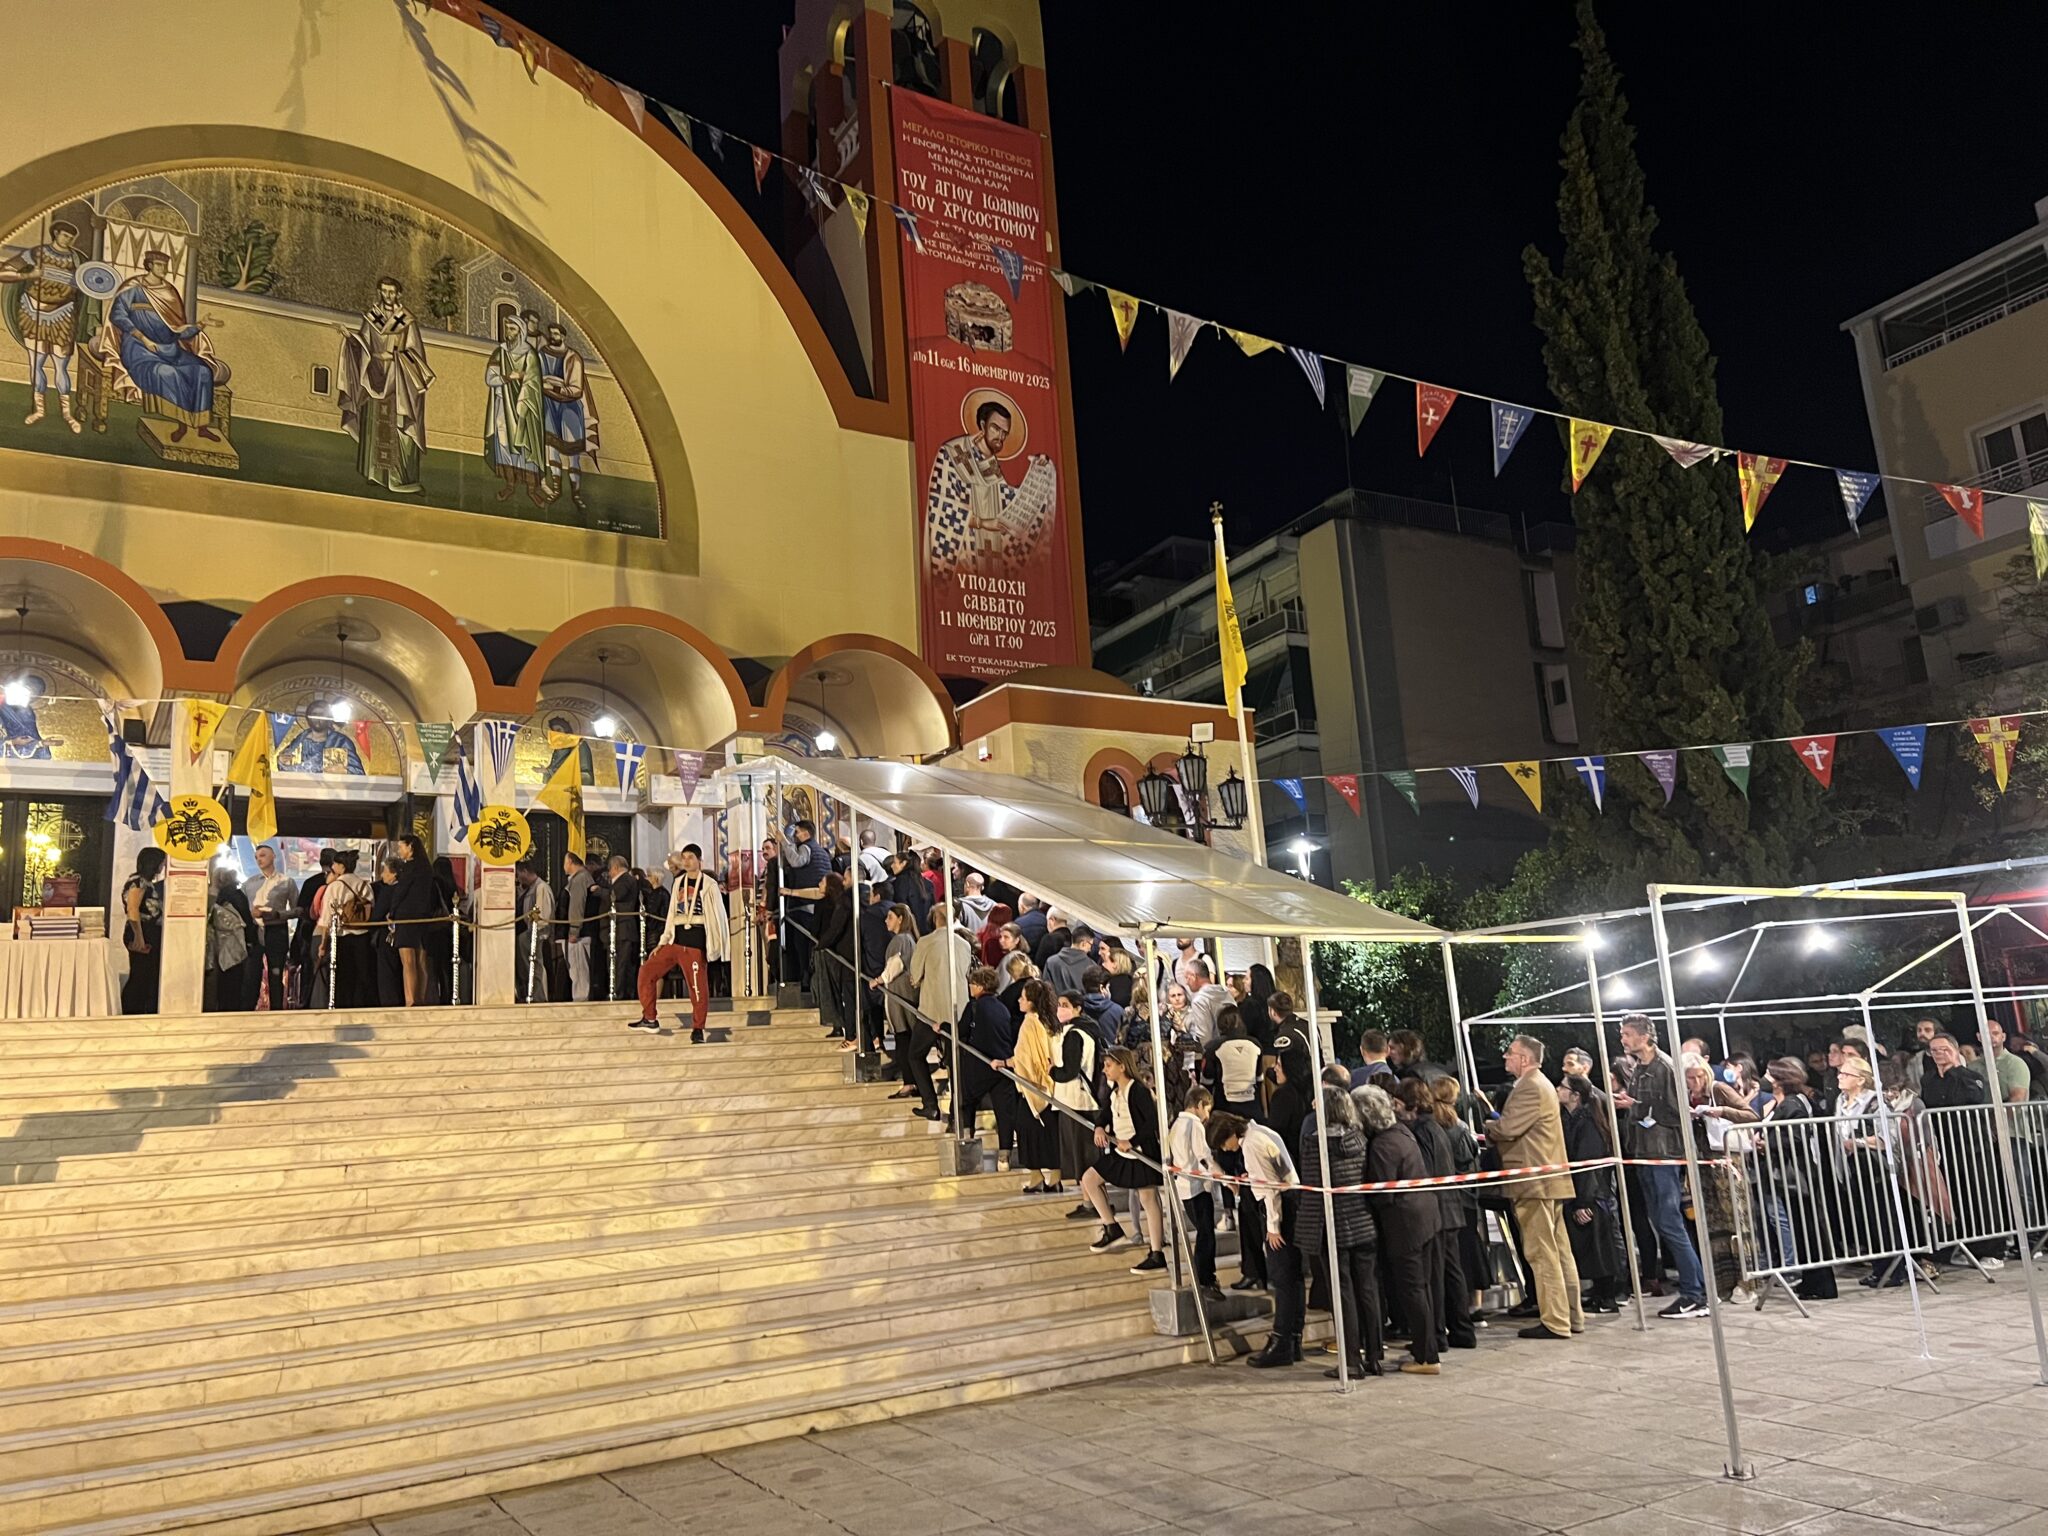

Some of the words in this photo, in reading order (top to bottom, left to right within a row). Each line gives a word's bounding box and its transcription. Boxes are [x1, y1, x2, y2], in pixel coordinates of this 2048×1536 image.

[902, 119, 945, 139] ΜΕΓΑΛΟ
[946, 133, 989, 154] ΙΣΤΟΡΙΚΟ
[990, 147, 1033, 168] ΓΕΓΟΝΟΣ
[902, 133, 911, 143] Η
[912, 136, 949, 154] ΕΝΟΡΙΑ
[950, 148, 971, 162] ΜΑΣ
[973, 156, 1034, 180] ΥΠΟΔΕΧΕΤΑΙ
[901, 168, 927, 191] ΤΟΥ
[927, 151, 943, 163] ΜΕ
[945, 156, 985, 176] ΜΕΓΑΛΗ
[986, 169, 1012, 183] ΤΙΜΗ
[931, 162, 953, 175] ΤΗΝ
[955, 169, 982, 185] ΤΙΜΙΑ
[984, 178, 1010, 192] ΚΑΡΑ
[908, 190, 936, 214] ΤΟΥ
[928, 349, 939, 367] 11
[957, 355, 971, 373] 16
[1026, 374, 1050, 390] 2023
[958, 573, 1026, 596] ΥΠΟΔΟΧΗ
[939, 610, 952, 626] 11
[1029, 619, 1057, 638] 2023
[945, 653, 957, 662] ΕΚ
[958, 655, 976, 664] ΤΟΥ
